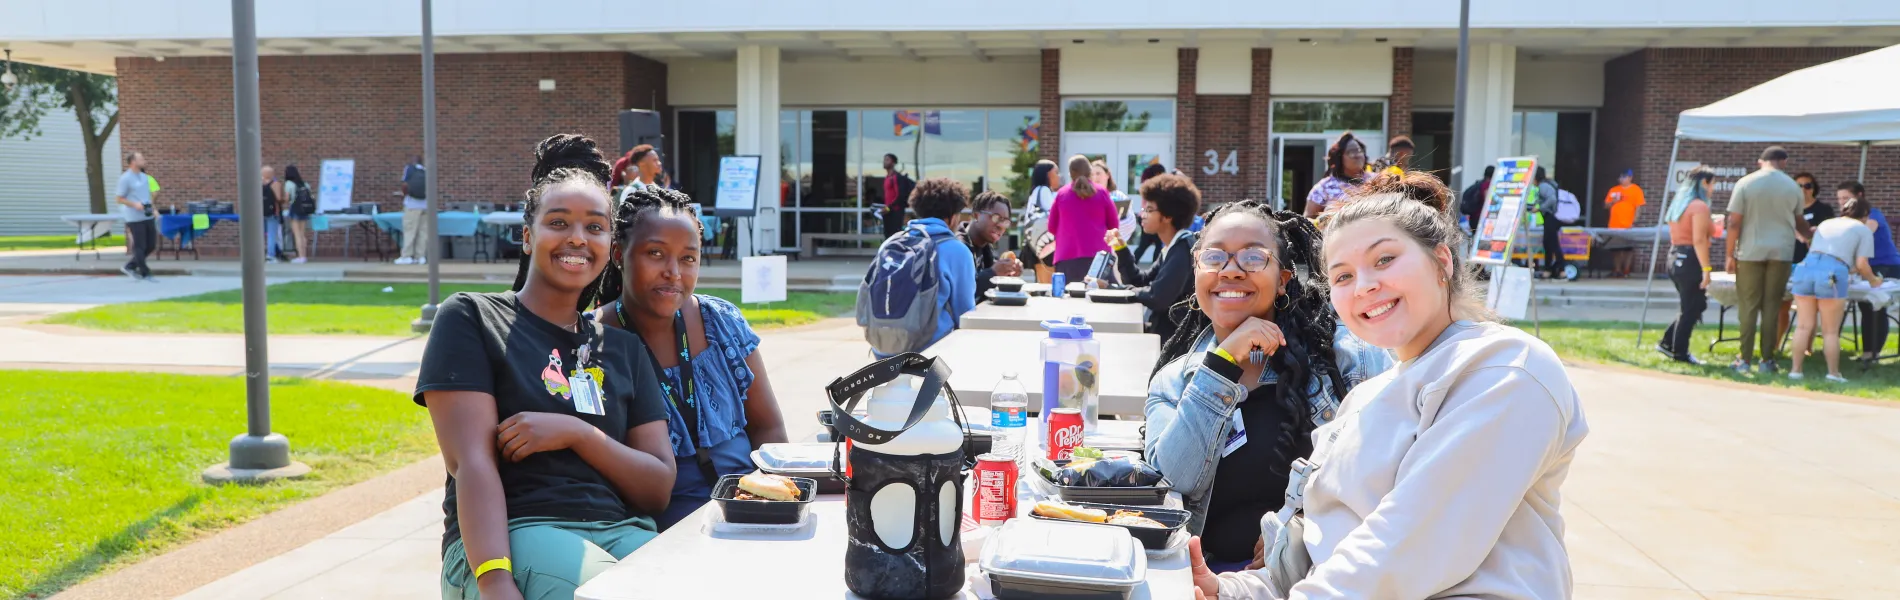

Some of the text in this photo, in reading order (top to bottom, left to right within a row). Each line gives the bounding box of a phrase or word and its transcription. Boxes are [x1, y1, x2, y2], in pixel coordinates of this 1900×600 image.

[1202, 149, 1240, 176] 34
[1714, 167, 1747, 178] mpus
[832, 373, 876, 397] HYDROJU
[1055, 428, 1085, 447] Peppe
[1069, 424, 1082, 437] Dr
